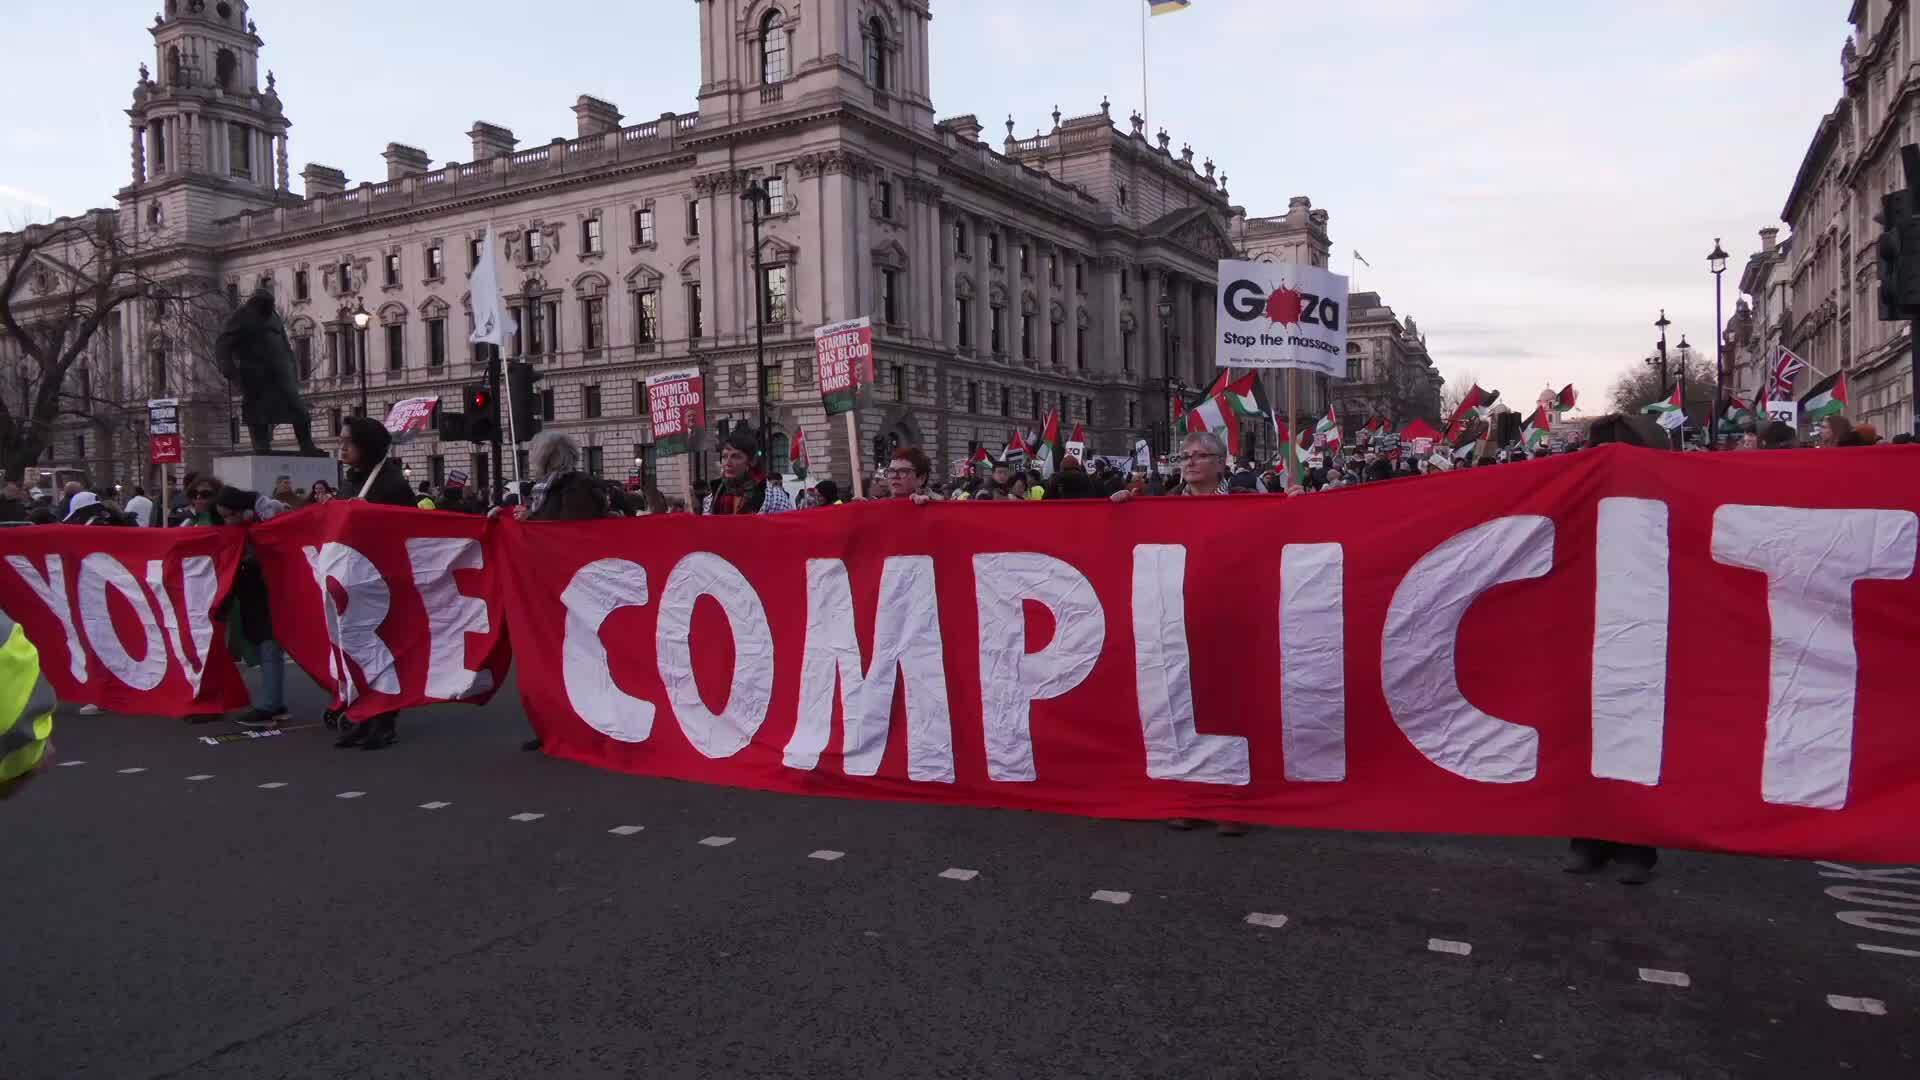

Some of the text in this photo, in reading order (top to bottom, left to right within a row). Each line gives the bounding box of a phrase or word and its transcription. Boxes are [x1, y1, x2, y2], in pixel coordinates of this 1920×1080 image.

[1223, 279, 1339, 331] Gza
[818, 332, 860, 352] STARMER
[1223, 332, 1340, 356] Stop the massacre
[819, 343, 869, 366] HAS BLOOD
[820, 360, 850, 379] ON HIS
[650, 381, 689, 400] STARMER
[822, 373, 850, 393] HANDS
[651, 392, 700, 413] HAS BLOOD
[652, 407, 681, 424] ON HIS
[654, 419, 681, 437] HANDS
[4, 552, 218, 700] YOU
[560, 497, 1919, 810] COMPLICIT
